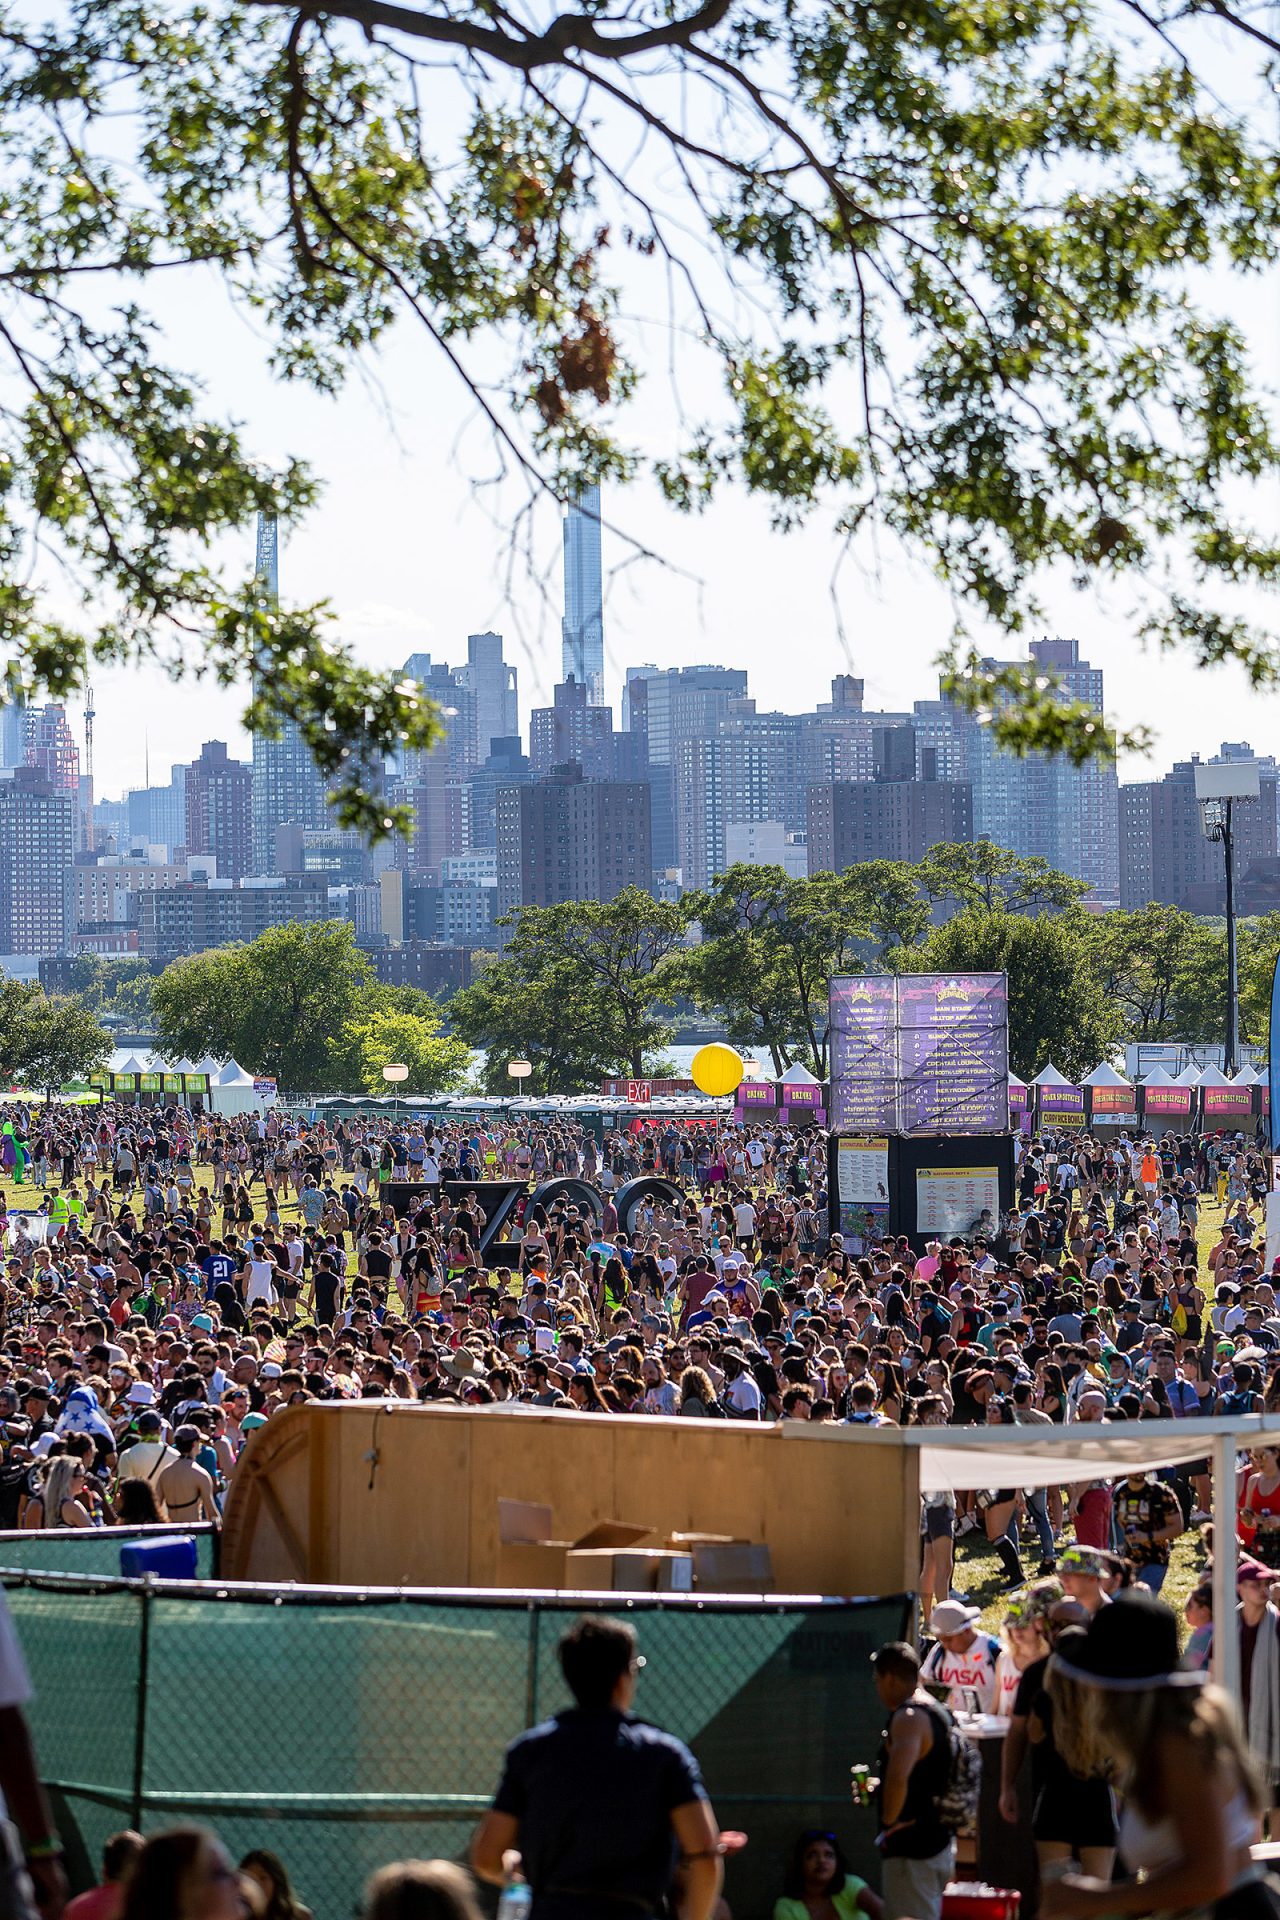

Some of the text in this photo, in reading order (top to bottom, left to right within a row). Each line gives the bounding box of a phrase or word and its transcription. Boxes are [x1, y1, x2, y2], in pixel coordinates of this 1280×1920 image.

[628, 1081, 650, 1101] EXIT
[747, 1090, 767, 1099] DRINKS
[792, 1091, 812, 1101] DRINKS
[1042, 1093, 1081, 1103] POWER SMOOTHIES
[1174, 1095, 1187, 1105] PIZZA
[1235, 1095, 1249, 1105] PIZZA
[1043, 1113, 1058, 1123] CURRY
[1057, 1113, 1068, 1123] RICE
[1068, 1114, 1084, 1125] BOWLS
[213, 1261, 228, 1278] 21
[940, 1668, 986, 1686] NASA
